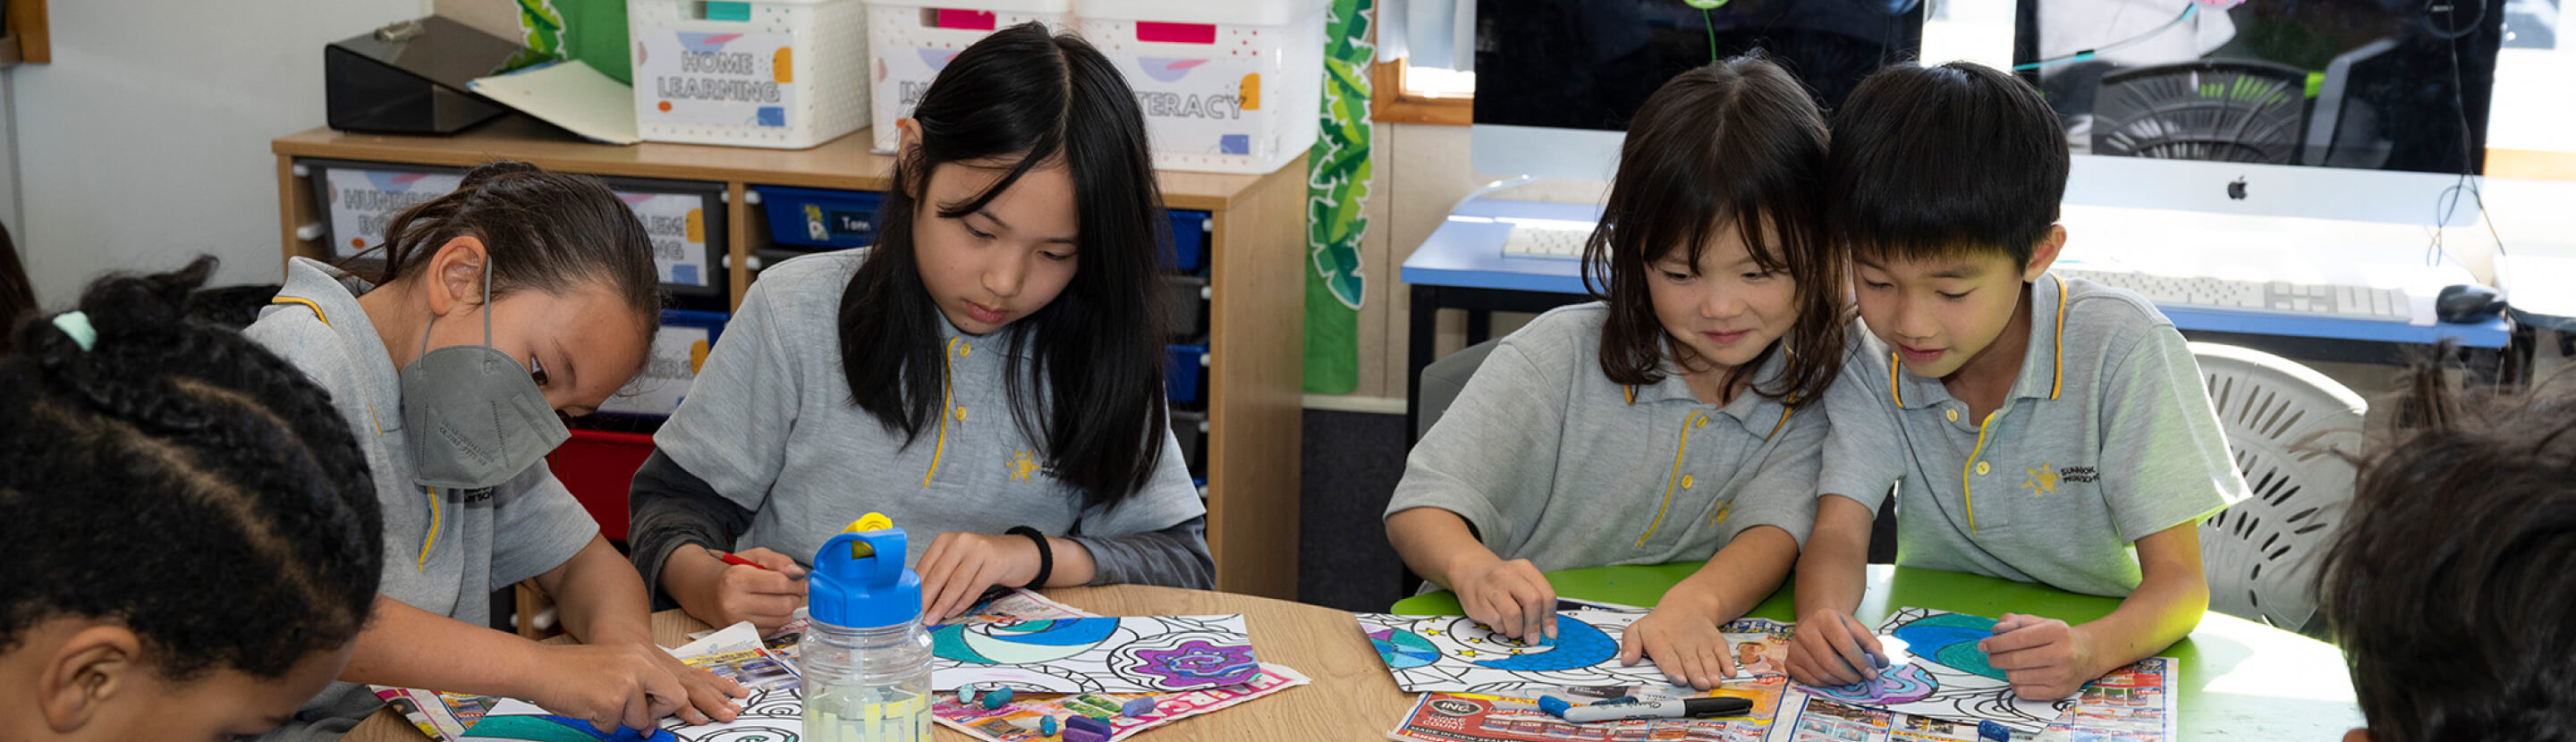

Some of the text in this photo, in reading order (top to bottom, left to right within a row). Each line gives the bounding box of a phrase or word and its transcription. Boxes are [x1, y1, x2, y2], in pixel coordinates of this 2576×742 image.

[682, 50, 754, 75] HOME
[657, 76, 781, 104] LEARNING
[1135, 91, 1247, 120] TERACY
[1440, 702, 1471, 713] ING
[1453, 732, 1477, 741] NEW
